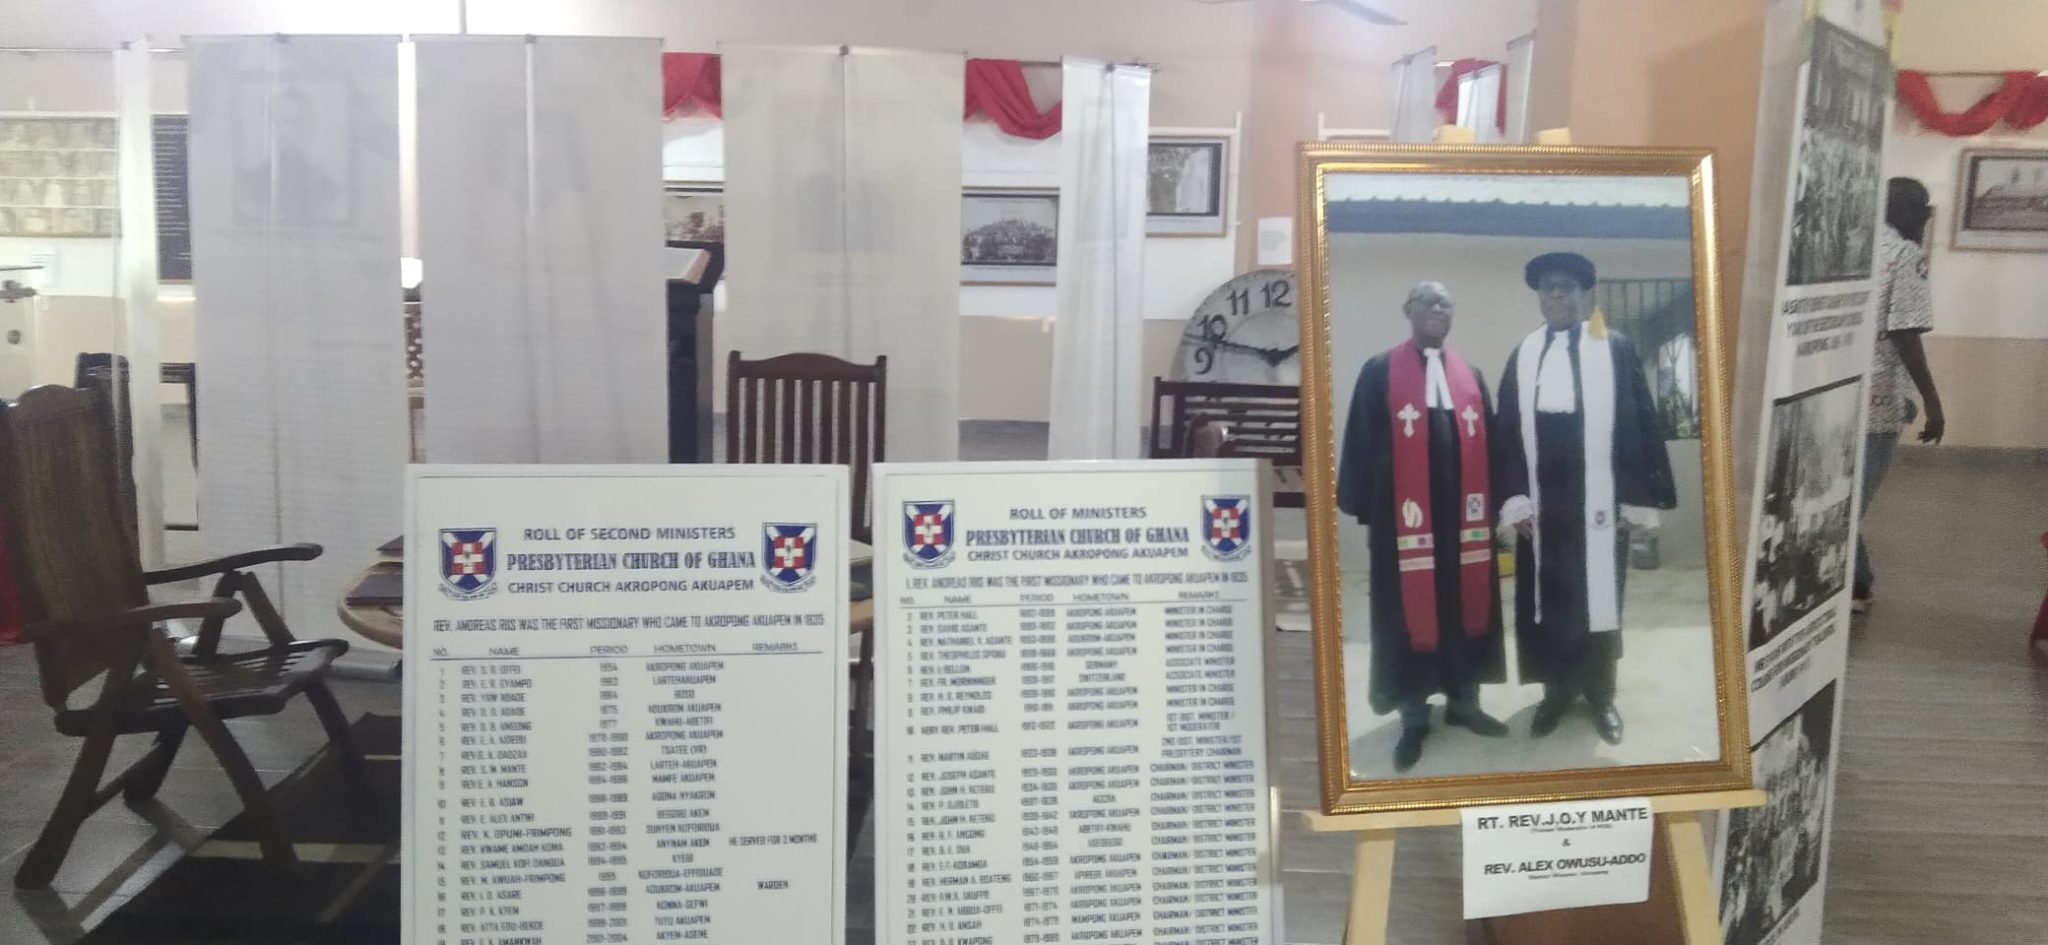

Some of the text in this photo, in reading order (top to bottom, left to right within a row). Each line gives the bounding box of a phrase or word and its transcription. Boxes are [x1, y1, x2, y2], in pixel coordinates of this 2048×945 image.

[1261, 279, 1291, 308] 12
[1227, 286, 1249, 316] 11
[1198, 313, 1227, 342] 10
[1195, 346, 1213, 375] 9
[1010, 507, 1146, 520] ROLL OF MINISTERS
[524, 527, 736, 540] ROLL OF SECOND MINISTERS
[966, 527, 1190, 547] PRESBYTERIAN CHURCH OF GHANA
[506, 550, 755, 571] PRESBYTERIAN CHURCH OF GHANA
[968, 551, 1008, 562] CHRIST
[1013, 550, 1060, 561] CHURCH
[1063, 549, 1129, 561] AKROPONG
[1132, 548, 1188, 559] AKUAPEM
[931, 572, 1229, 588] ANDREAS WAS THE FIRST MISSIONARY WHO CAME TO AKROPONG AKUAPEM IN
[508, 582, 554, 593] CHRIST
[558, 581, 610, 593] CHURCH
[615, 581, 688, 593] AKROPONG
[691, 580, 754, 592] AKUAPEM
[944, 595, 971, 603] NAME
[1020, 594, 1054, 602] PERIOD
[1073, 592, 1130, 601] HOMETOWN
[1178, 591, 1221, 599] REMARKS
[1165, 605, 1233, 615] MINISTER CHARGE
[456, 619, 496, 631] ANDREAS
[519, 618, 538, 630] WAS
[541, 618, 557, 629] THE
[560, 617, 583, 629] FIRST
[587, 617, 639, 629] MISSIONARY
[643, 616, 662, 628] WHO
[664, 616, 687, 628] CAME
[691, 615, 703, 627] TO
[705, 615, 749, 627] AKROPONG
[752, 614, 791, 626] AKUAPEM
[793, 614, 802, 625] IN
[433, 648, 449, 656] NO.
[489, 647, 520, 656] NAME
[591, 645, 629, 654] PERIOD
[654, 644, 716, 653] HOMETOWN
[753, 642, 798, 652] REMARKS
[646, 661, 724, 672] AKROPONG AKUAPEM
[687, 703, 722, 713] AKUAPEM
[646, 730, 724, 741] AKROPONG AKUAPEM
[501, 764, 526, 774] MANTE
[1191, 760, 1254, 771] DISTRICT MINISTER
[681, 773, 715, 783] AKUAPEM
[511, 813, 535, 823] ANTWI
[1478, 817, 1504, 830] RT.
[1508, 811, 1588, 829] REV.J.O.Y
[1592, 807, 1649, 824] MANTE
[494, 828, 572, 839] OPUNI-FRIMPONG
[1193, 832, 1256, 843] DISTRICT MINISTER
[729, 837, 738, 847] HE
[768, 835, 782, 845] FOR
[1562, 838, 1570, 847] &
[480, 844, 509, 854] KWAME
[480, 859, 511, 870] SAMUEL
[1484, 862, 1516, 876] REV.
[1518, 859, 1552, 873] ALEX
[1556, 852, 1646, 872] OWUSU-ADDO
[757, 880, 788, 890] WARDEN
[1195, 906, 1258, 918] DISTRICT MINISTER
[676, 915, 711, 925] AKUAPEM
[1071, 928, 1142, 940] AKROPONG AKUAPEM
